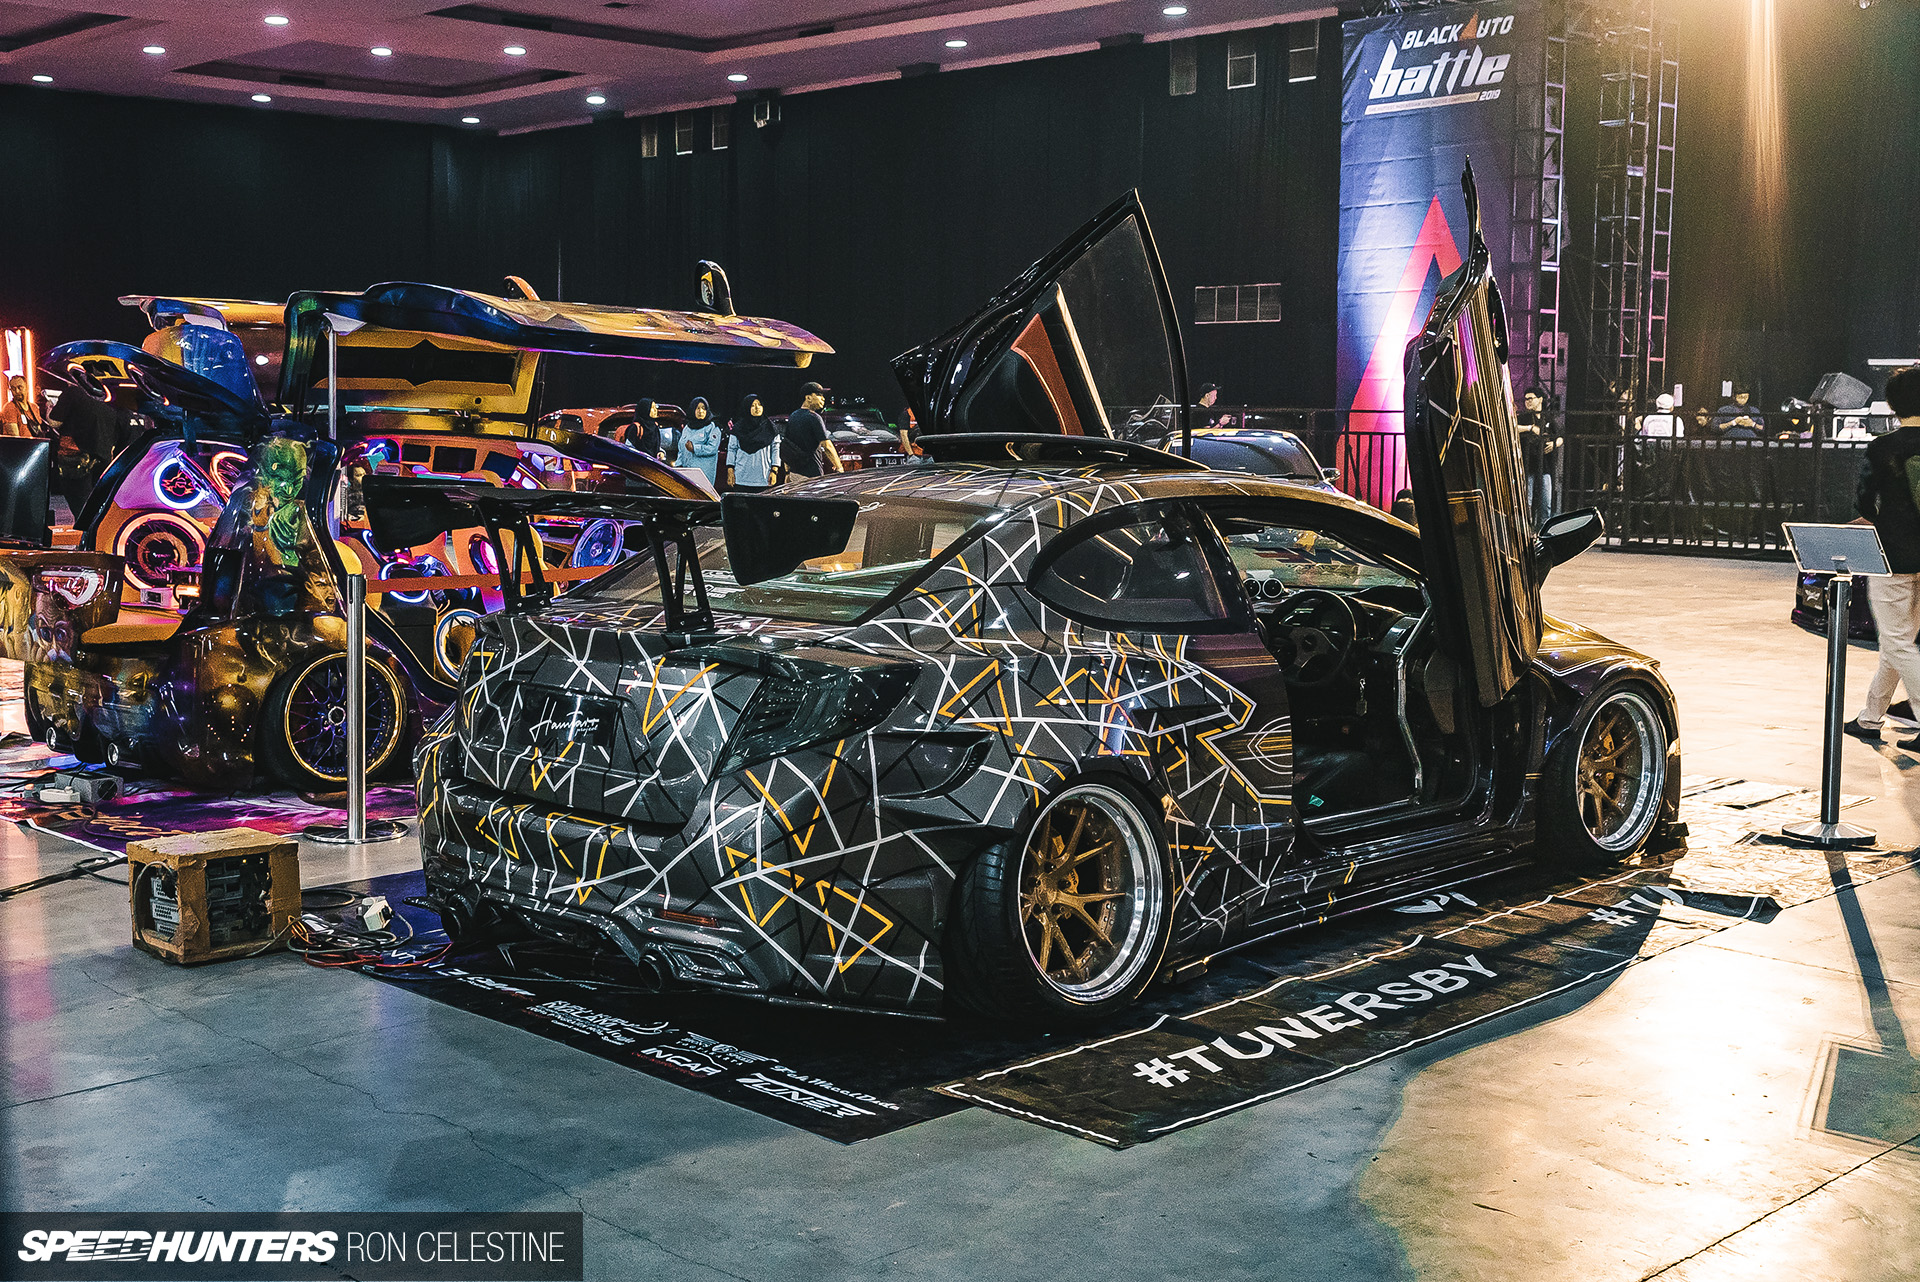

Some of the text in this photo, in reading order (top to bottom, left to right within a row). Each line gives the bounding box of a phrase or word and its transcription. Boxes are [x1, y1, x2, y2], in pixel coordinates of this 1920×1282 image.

[1369, 39, 1511, 100] battle
[1479, 89, 1501, 101] 2019
[1133, 954, 1498, 1089] #TUNERSBY
